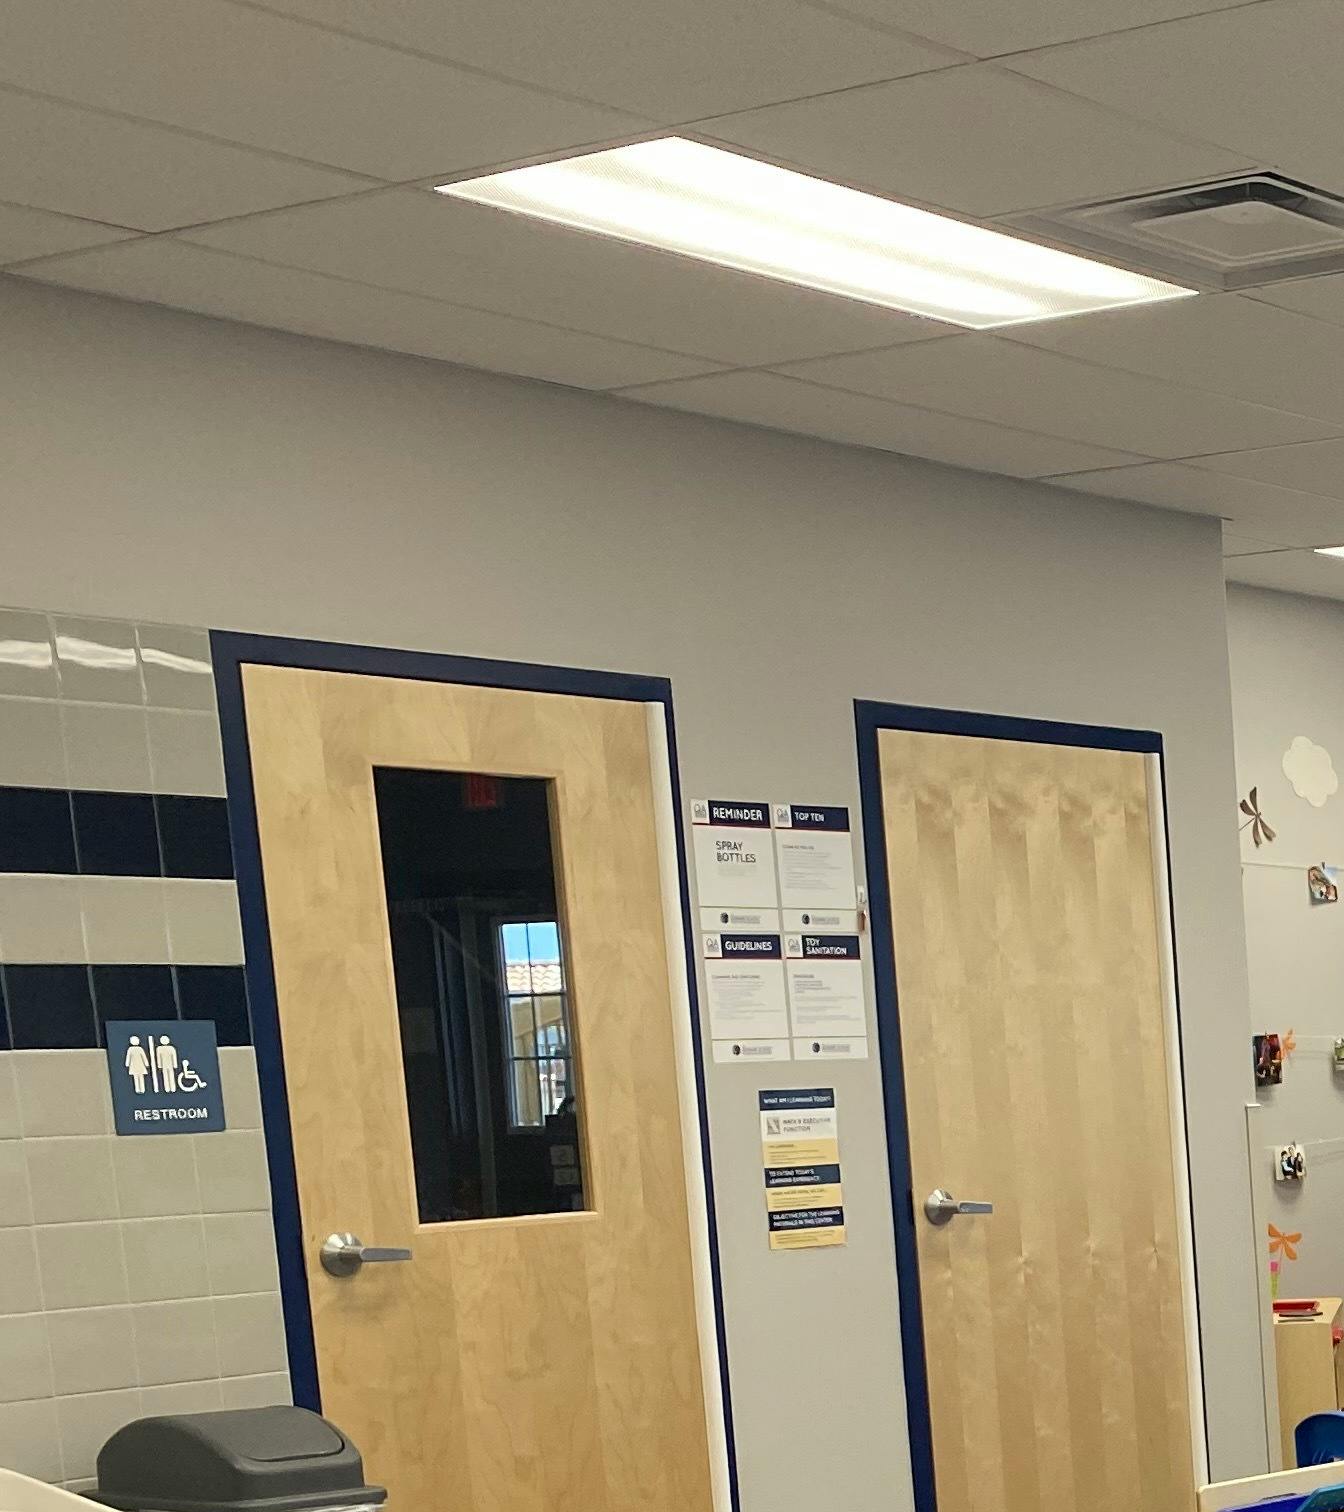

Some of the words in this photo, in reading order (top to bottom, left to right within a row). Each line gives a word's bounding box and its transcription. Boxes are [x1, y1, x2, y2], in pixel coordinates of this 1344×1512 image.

[713, 807, 763, 821] REMINDER
[794, 812, 810, 821] TOP
[811, 812, 825, 822] TEN
[715, 841, 743, 851] SPRAY
[717, 852, 757, 863] BOTTLES
[724, 940, 772, 951] GUIDELINES
[806, 946, 847, 955] SANITATION
[134, 1108, 208, 1120] RESTROOM
